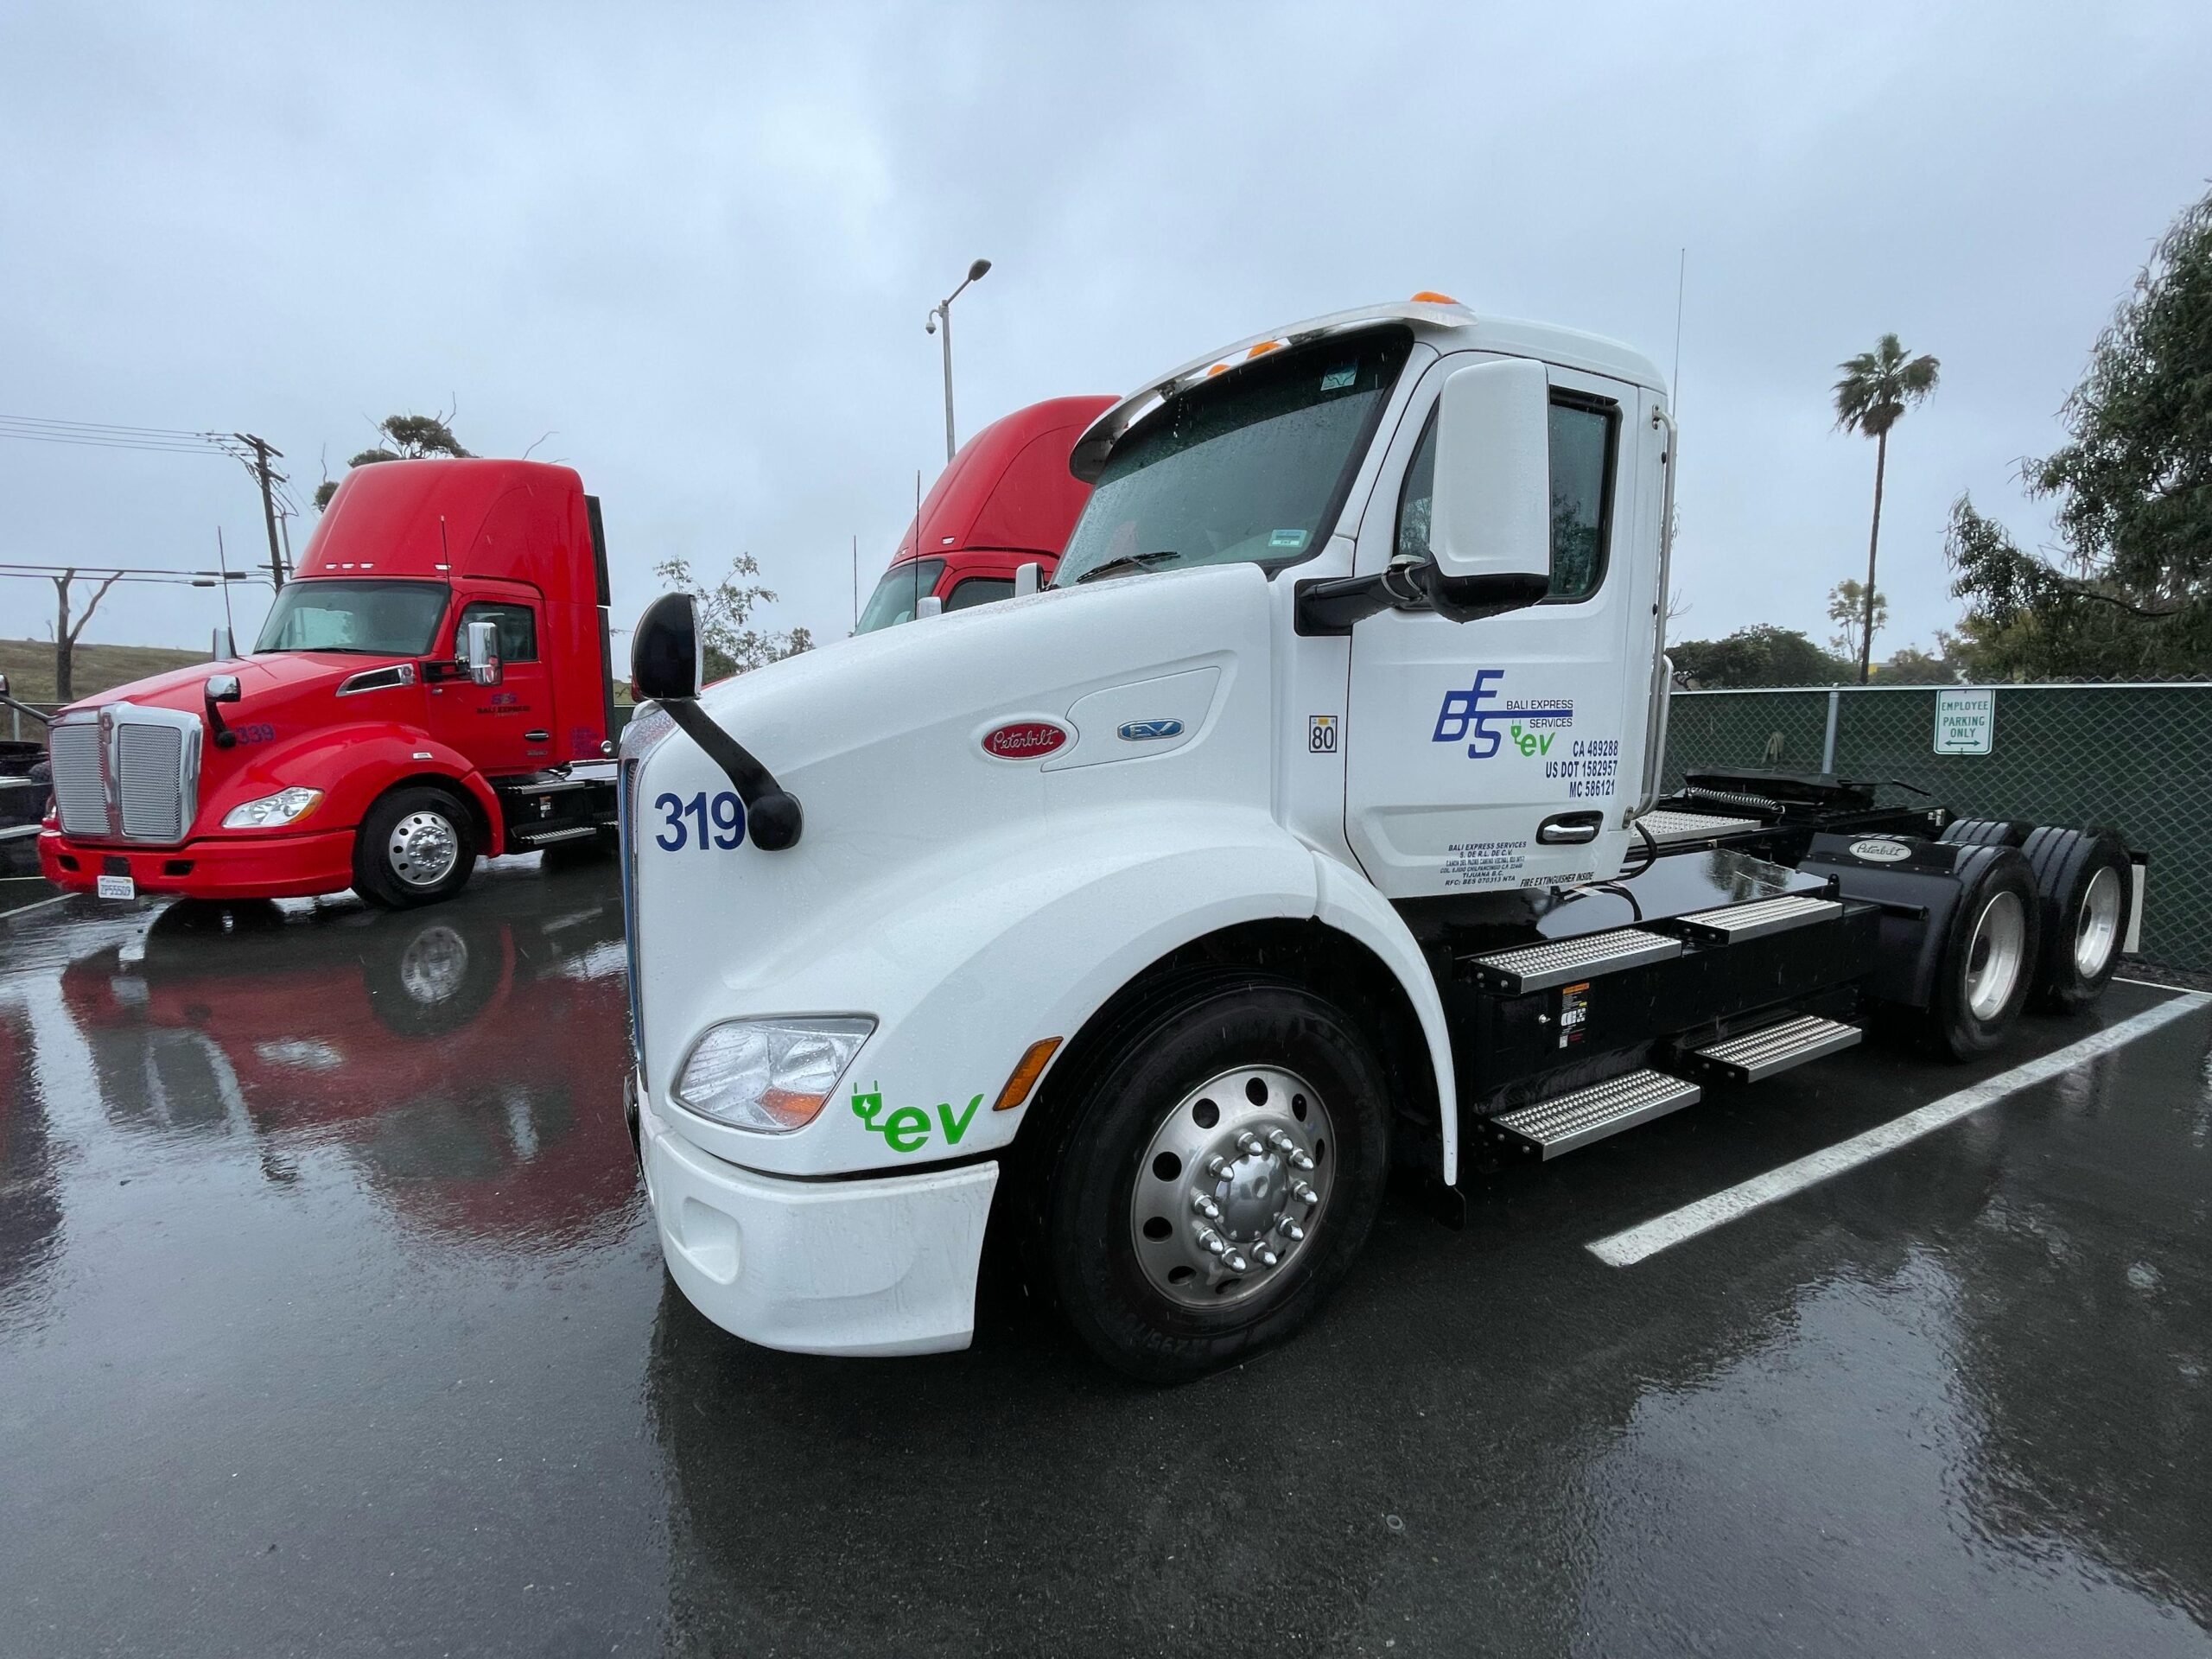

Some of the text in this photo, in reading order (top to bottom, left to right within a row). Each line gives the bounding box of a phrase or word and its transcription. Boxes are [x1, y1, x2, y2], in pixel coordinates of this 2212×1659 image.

[1507, 700, 1573, 710] BALI EXPRESS
[1942, 701, 1989, 711] EMPLOYEE
[1529, 718, 1573, 728] SERVICES
[1942, 715, 1985, 727] PARKING
[235, 723, 274, 745] 339
[993, 728, 1059, 753] Peterbilt
[1312, 726, 1334, 749] 80
[1950, 728, 1976, 738] ONLY
[1520, 731, 1556, 757] ev
[1573, 740, 1618, 758] CA 489288
[1546, 760, 1618, 779] US DOT 1582957
[1569, 779, 1616, 798] MC 586121
[654, 791, 746, 852] 319
[1448, 843, 1464, 852] BALI
[1465, 842, 1495, 851] EXPRESS
[1857, 842, 1905, 856] Peterbilt
[1520, 872, 1595, 887] FIRE EXTINGUISHER INSIDE
[883, 1092, 985, 1153] ev
